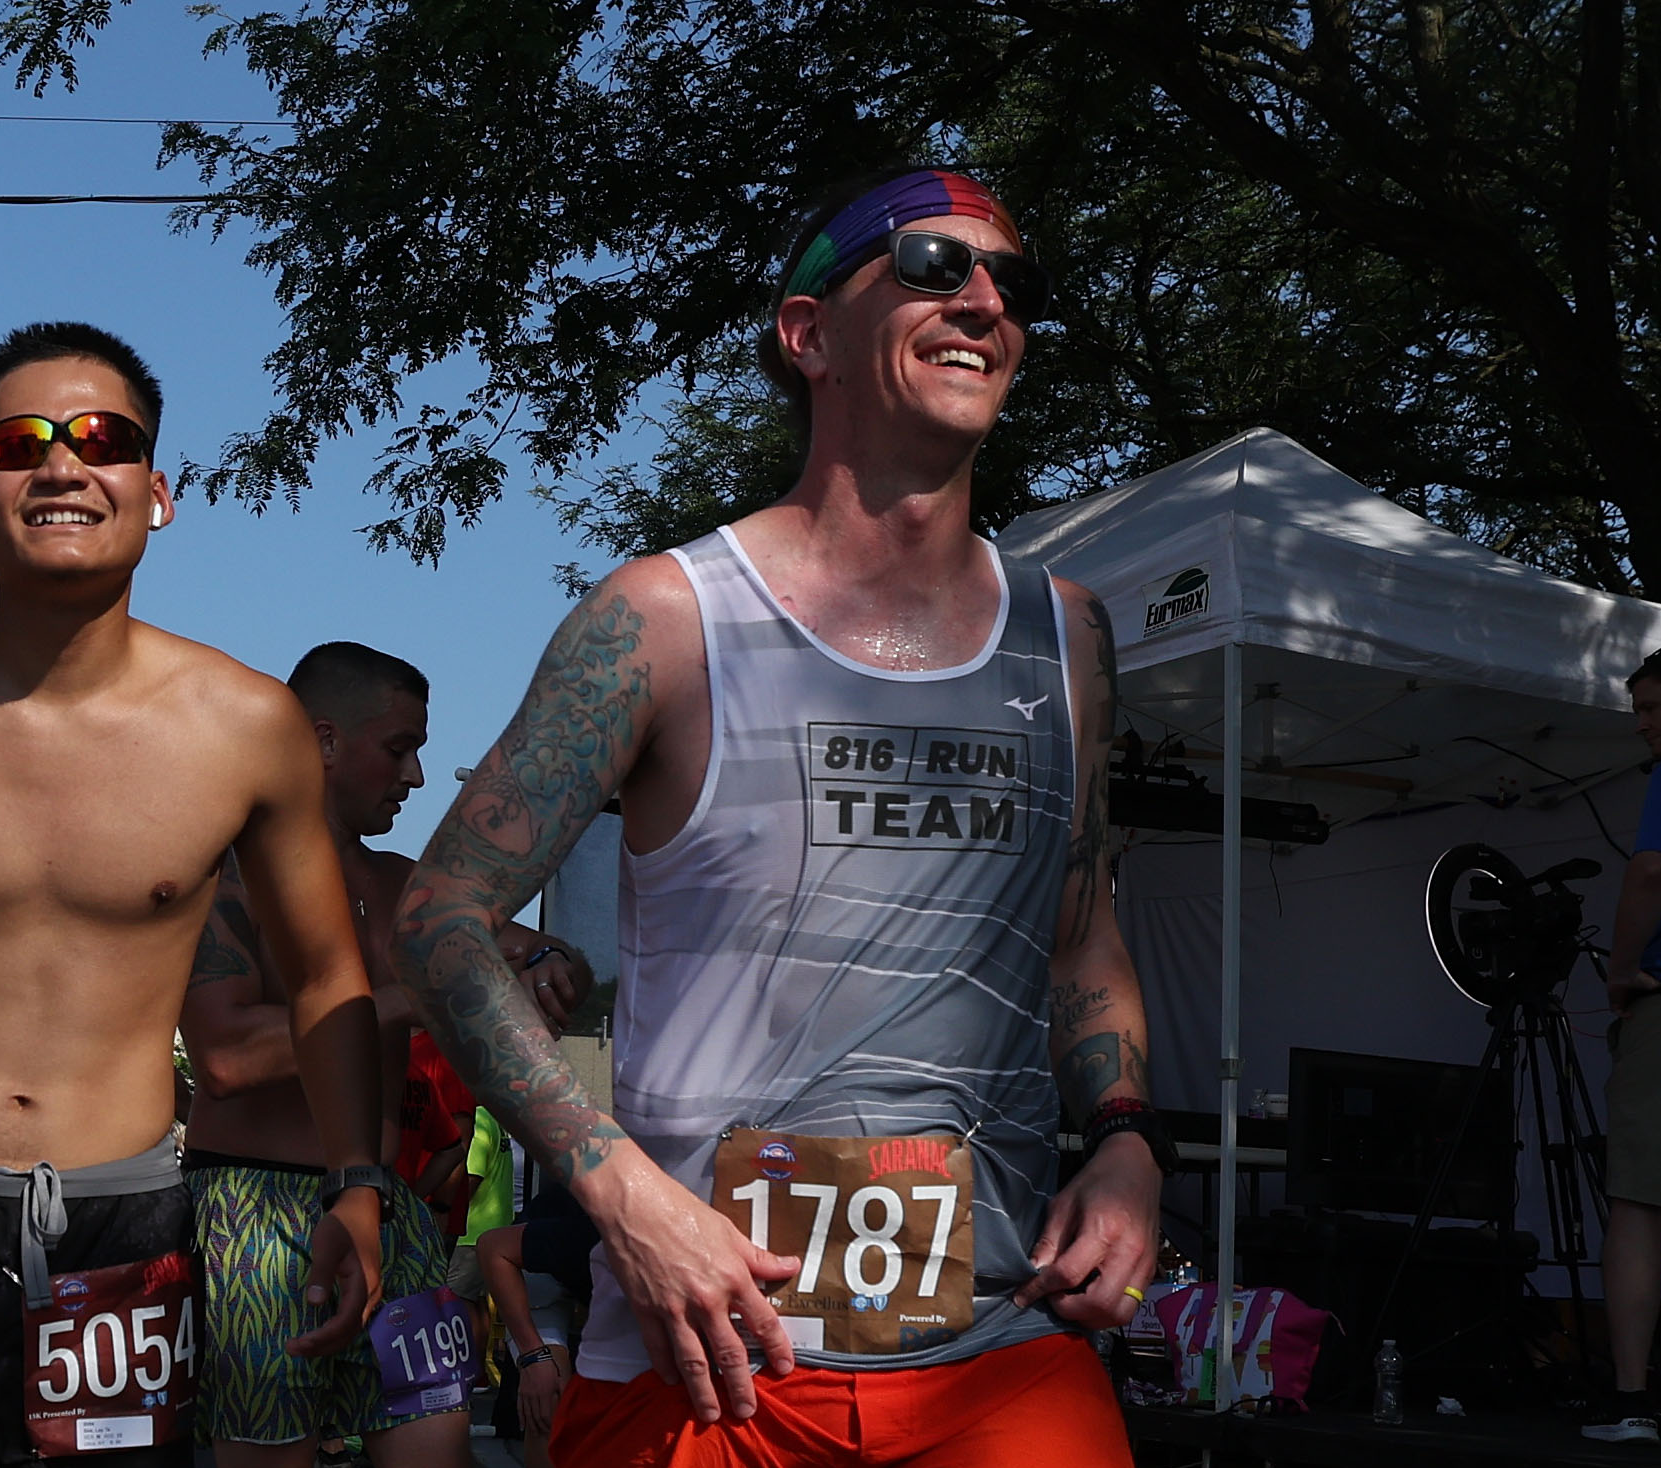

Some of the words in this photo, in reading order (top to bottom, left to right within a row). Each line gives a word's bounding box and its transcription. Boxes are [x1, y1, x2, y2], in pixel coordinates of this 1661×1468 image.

[1145, 588, 1205, 629] Eurmax
[825, 736, 895, 772] 816
[926, 740, 1016, 778] RUN
[826, 790, 1015, 843] TEAM
[868, 1139, 953, 1181] SARANAC
[732, 1178, 958, 1298] 1787
[899, 1314, 934, 1323] Powered
[934, 1314, 947, 1325] By
[38, 1295, 197, 1403] 5054
[391, 1315, 470, 1381] 1199
[43, 1409, 75, 1419] Presented
[74, 1408, 86, 1417] By
